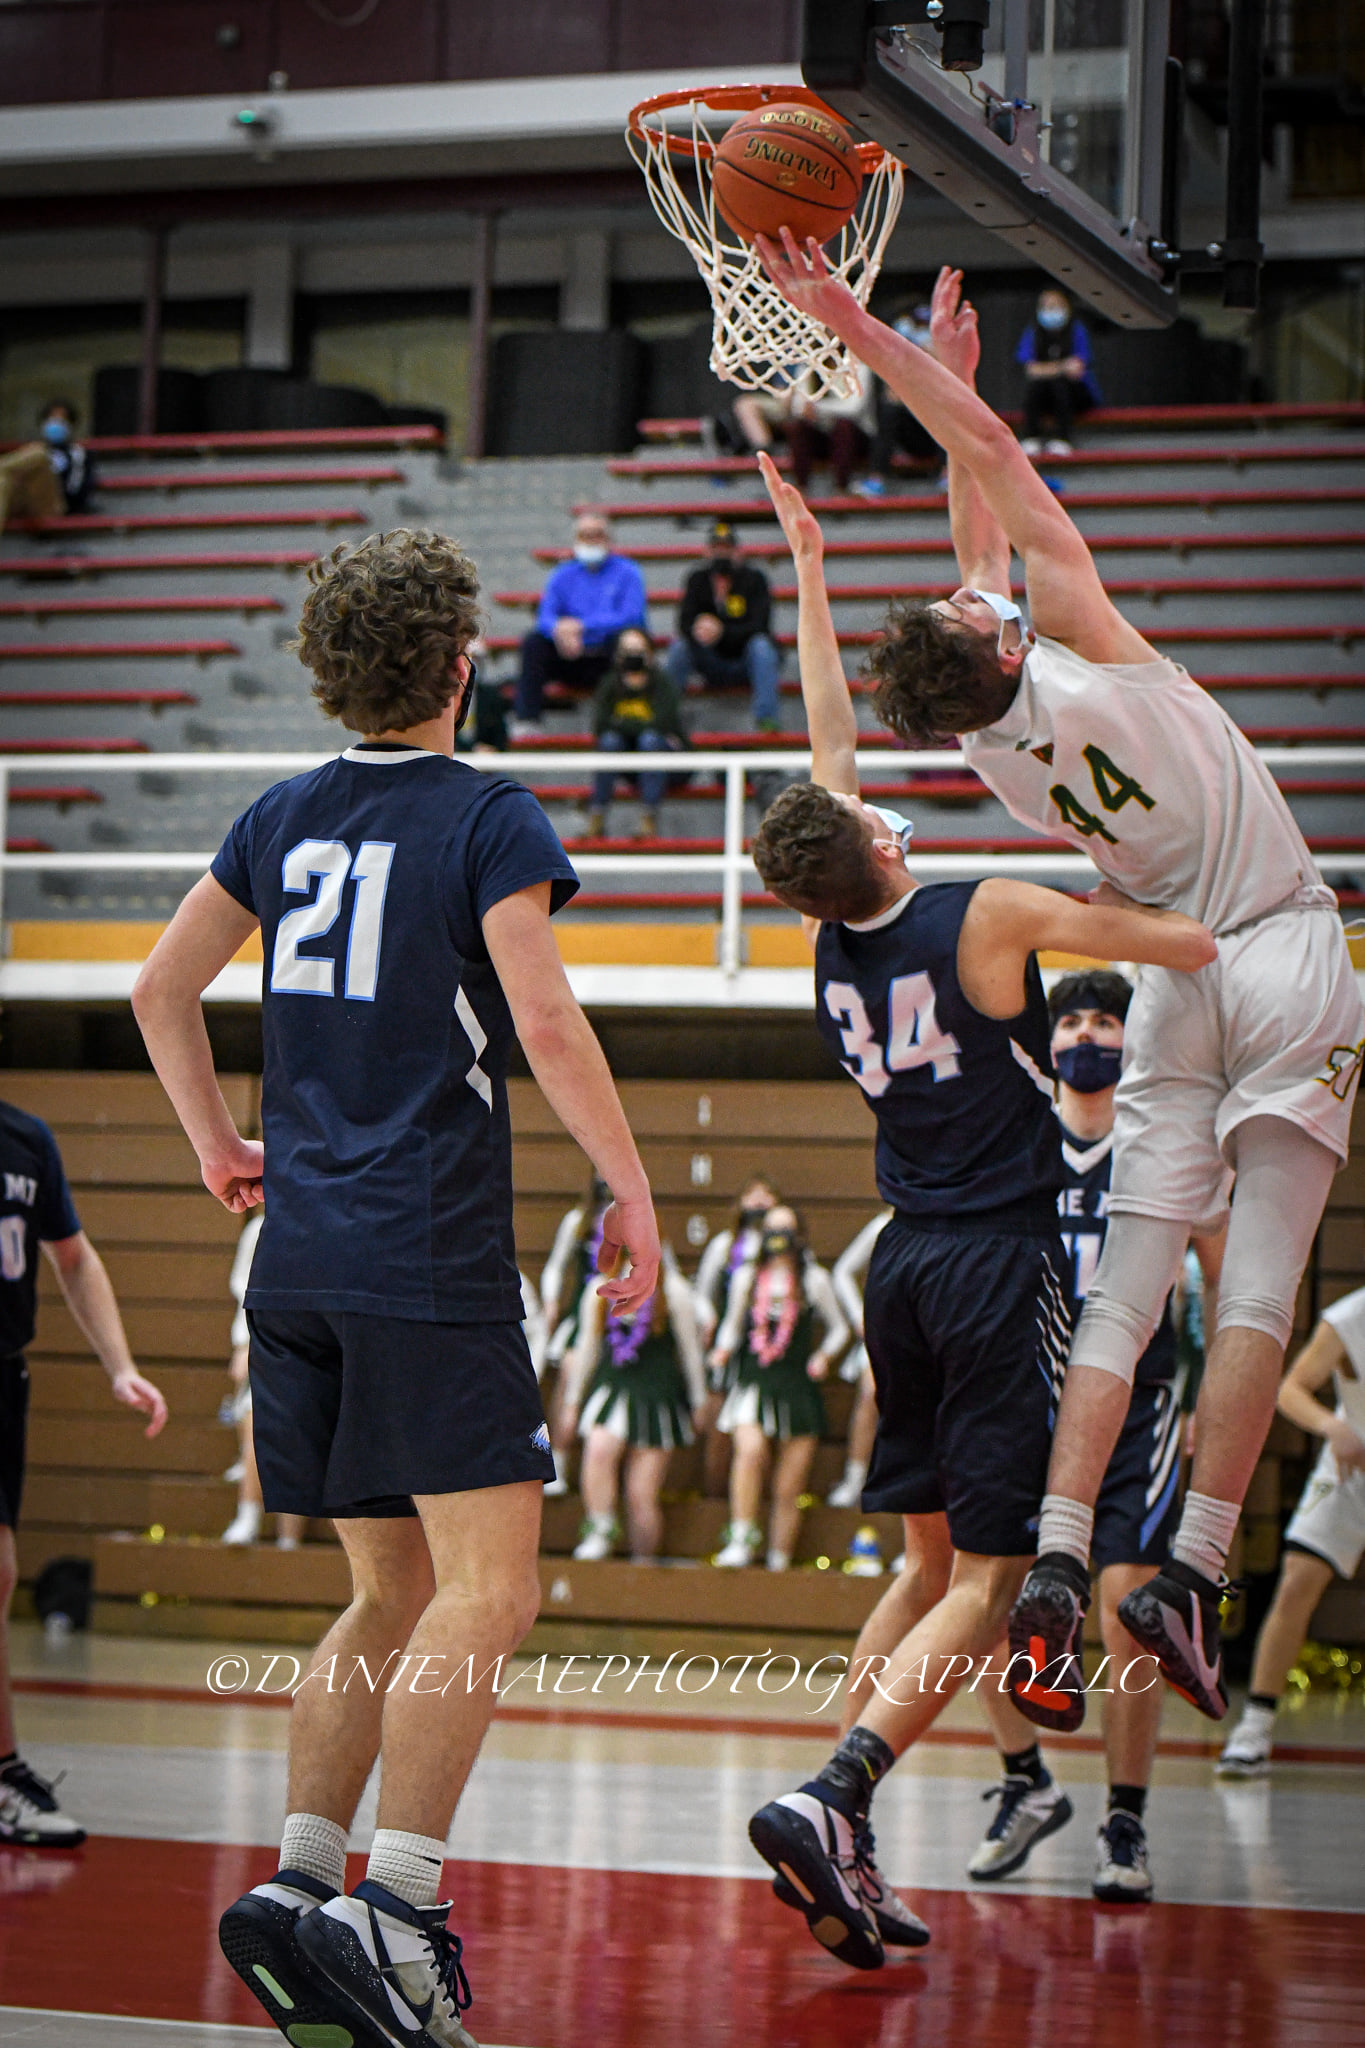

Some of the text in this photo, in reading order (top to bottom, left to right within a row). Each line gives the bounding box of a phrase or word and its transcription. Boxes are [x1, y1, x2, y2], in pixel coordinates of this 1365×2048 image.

[744, 136, 839, 191] SPALDING
[1049, 743, 1157, 844] 44
[270, 838, 397, 1002] 21
[823, 970, 962, 1098] 34
